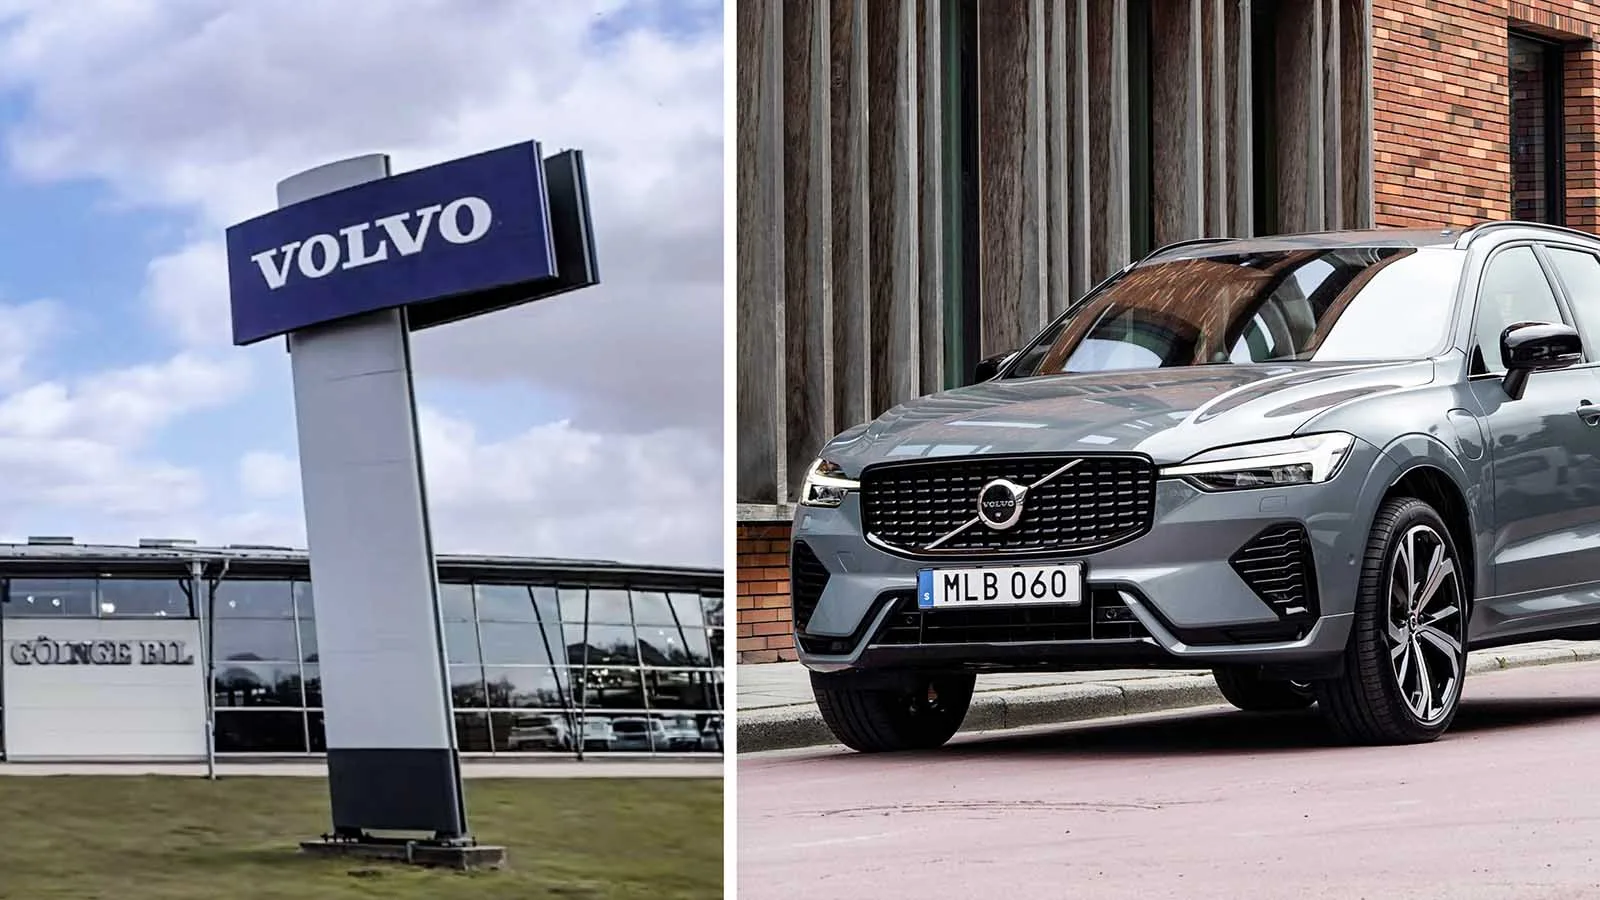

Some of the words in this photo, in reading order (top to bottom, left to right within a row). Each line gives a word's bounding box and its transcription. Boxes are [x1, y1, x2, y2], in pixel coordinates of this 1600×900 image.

[251, 196, 492, 290] VOLVO
[982, 500, 1015, 508] VOLVO
[923, 592, 930, 601] S
[943, 572, 999, 602] MLB
[1011, 570, 1067, 599] 060
[10, 635, 132, 665] GÖINGE
[139, 641, 195, 665] BIL
